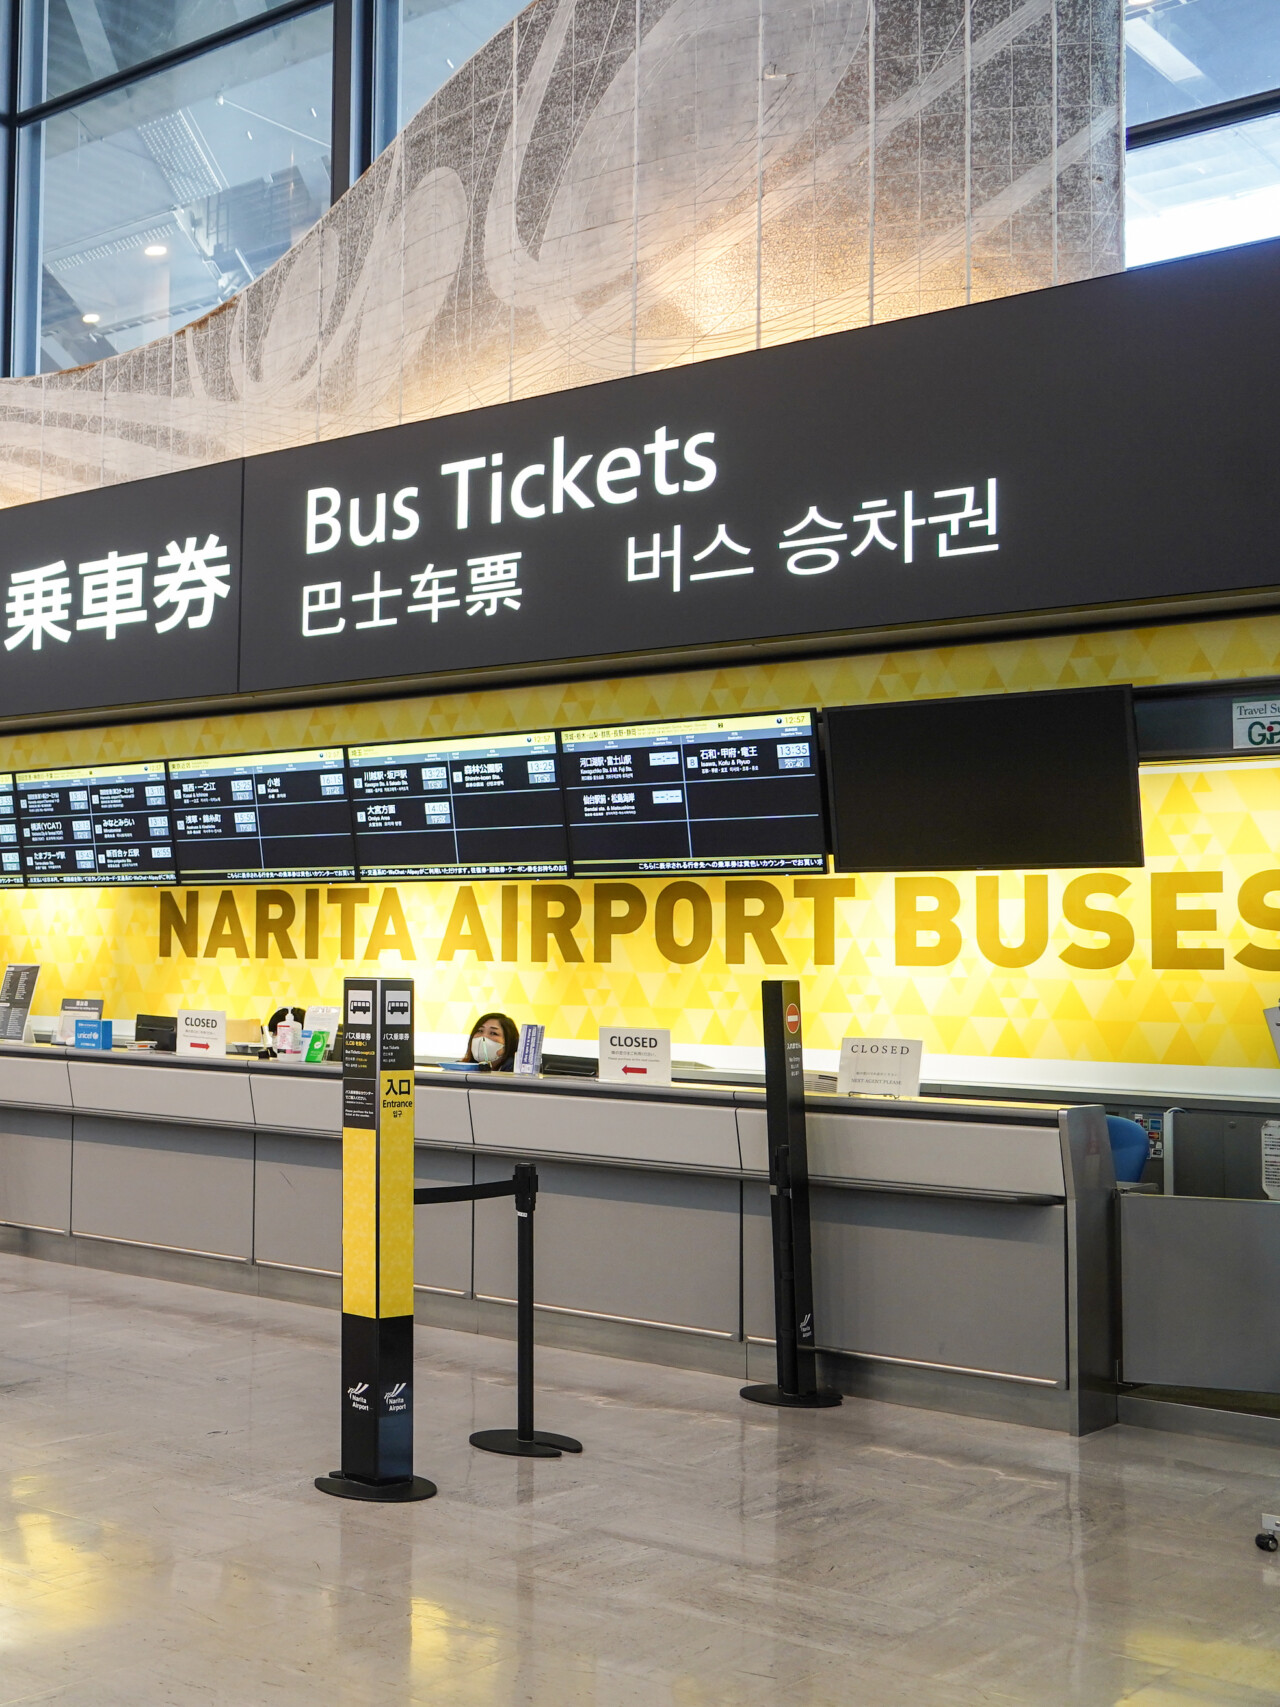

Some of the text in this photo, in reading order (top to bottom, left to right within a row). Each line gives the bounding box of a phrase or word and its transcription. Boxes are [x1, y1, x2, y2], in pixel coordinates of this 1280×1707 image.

[305, 425, 718, 555] Bus Tickets
[626, 477, 1000, 593] 버스 승차권
[301, 551, 523, 638] 巴士车票
[1237, 704, 1267, 716] Travel
[784, 715, 805, 724] 12:57
[779, 746, 808, 756] 13:35
[102, 818, 136, 828] みなとみらい
[159, 872, 1280, 972] NARITA AIRPORT BUSES
[184, 1016, 218, 1029] CLOSED
[345, 1032, 371, 1040] バス乗車券
[610, 1036, 658, 1048] CLOSED
[850, 1044, 910, 1055] CLOSED
[385, 1079, 410, 1096] 入口
[382, 1100, 412, 1108] Entrance
[352, 1395, 367, 1404] Narita
[352, 1402, 369, 1411] Airport
[389, 1404, 407, 1412] Airport
